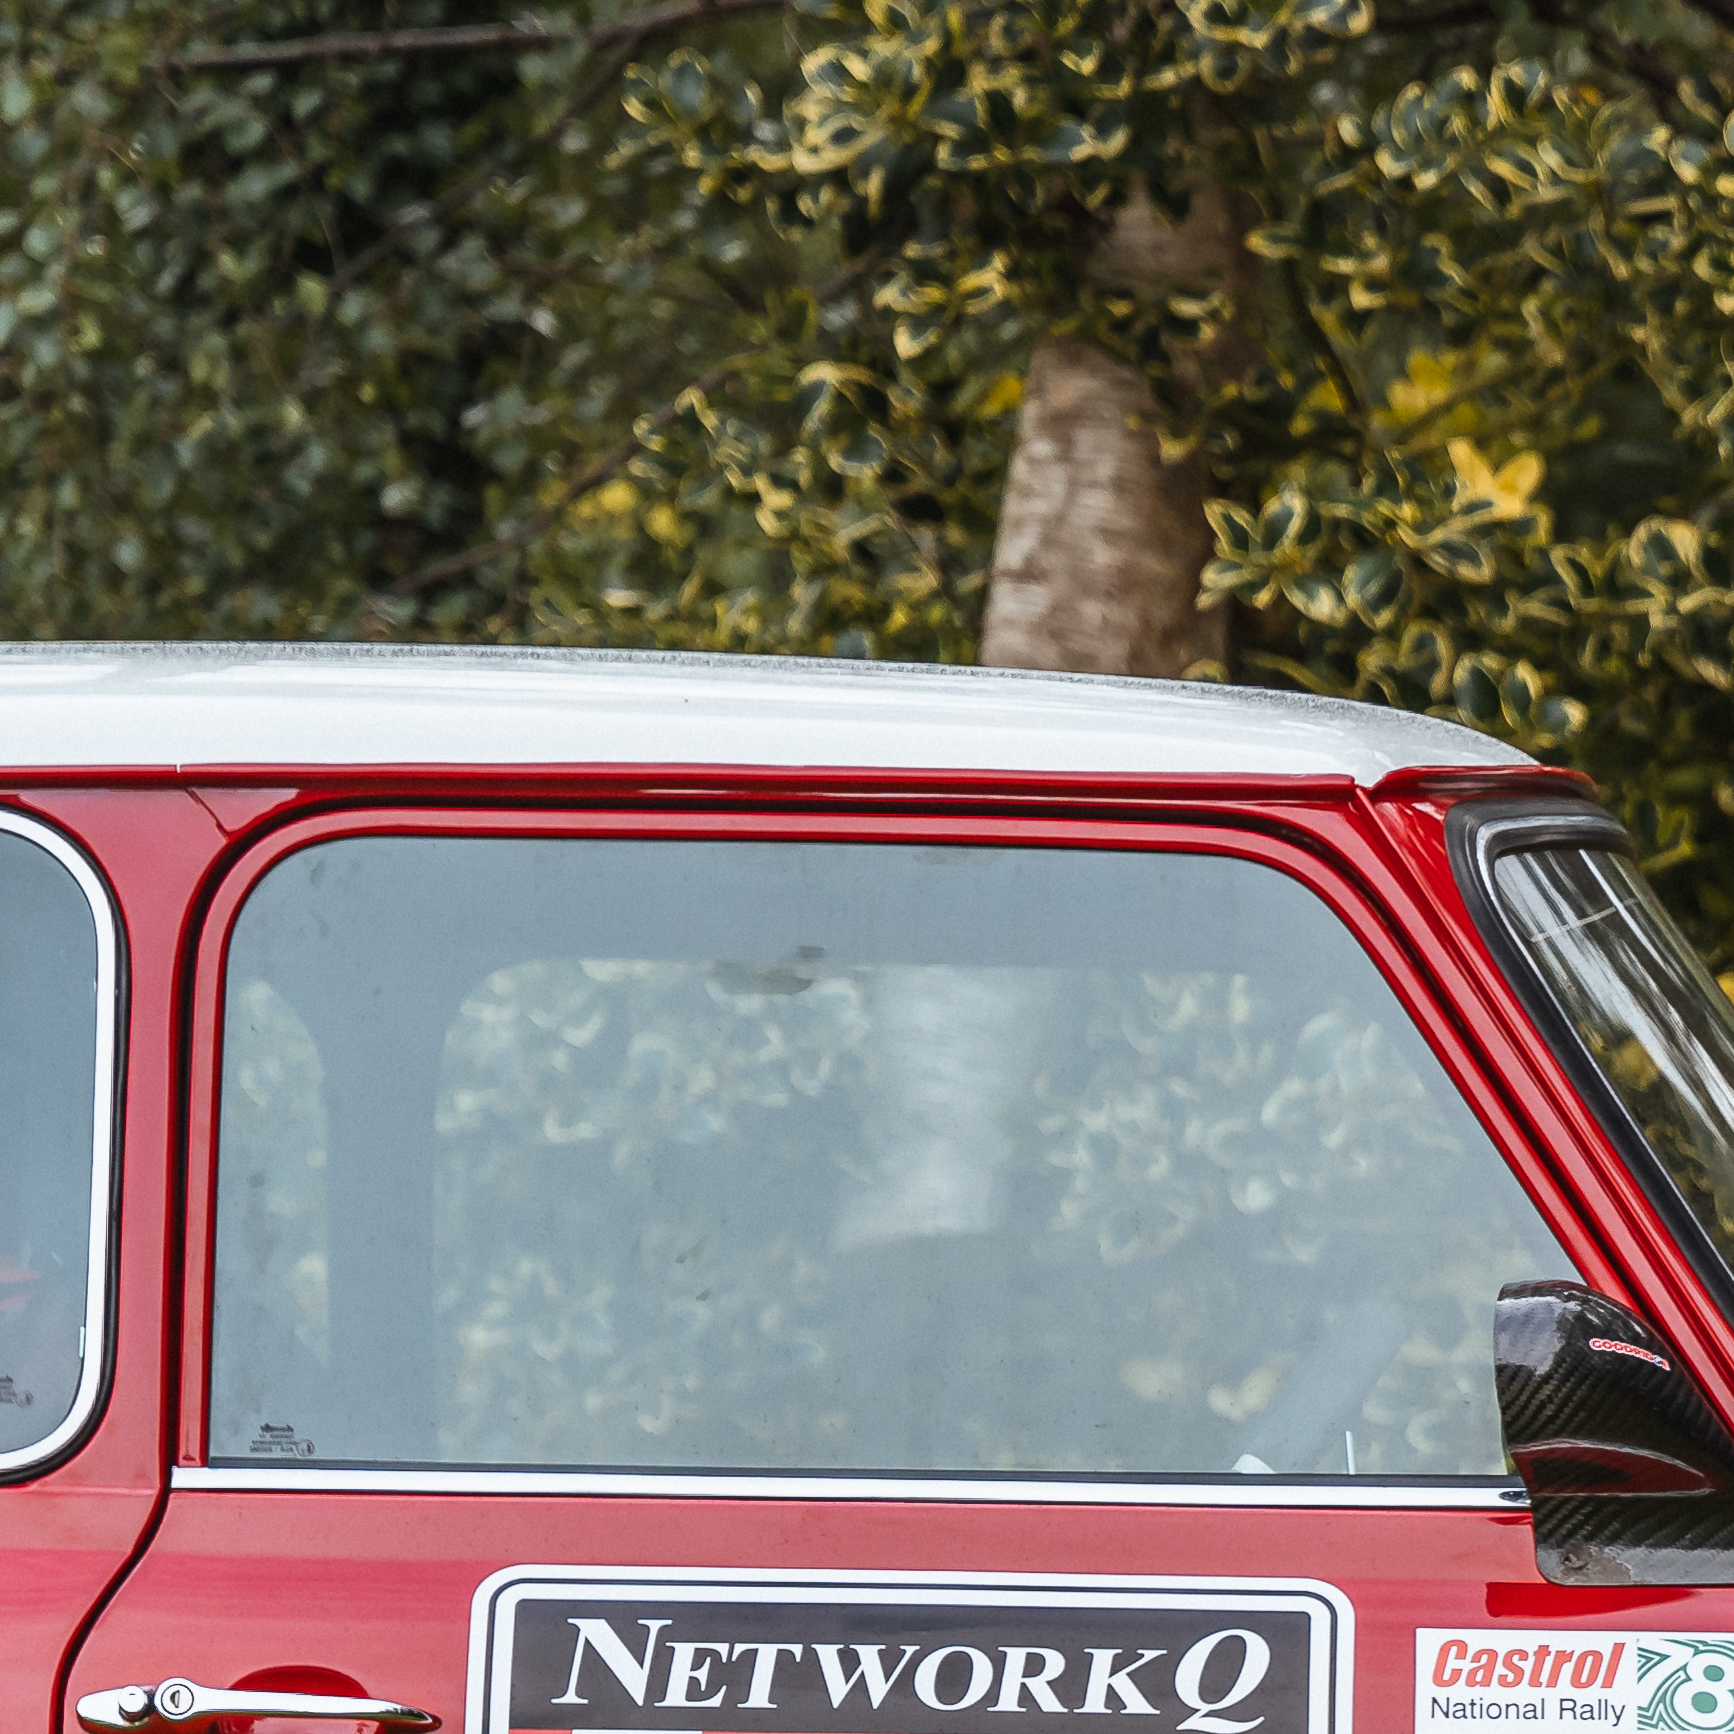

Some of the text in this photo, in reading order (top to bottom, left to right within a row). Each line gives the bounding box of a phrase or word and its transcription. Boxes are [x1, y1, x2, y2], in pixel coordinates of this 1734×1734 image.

[1431, 1639, 1627, 1689] Castrol
[1430, 1696, 1627, 1728] National Rally
